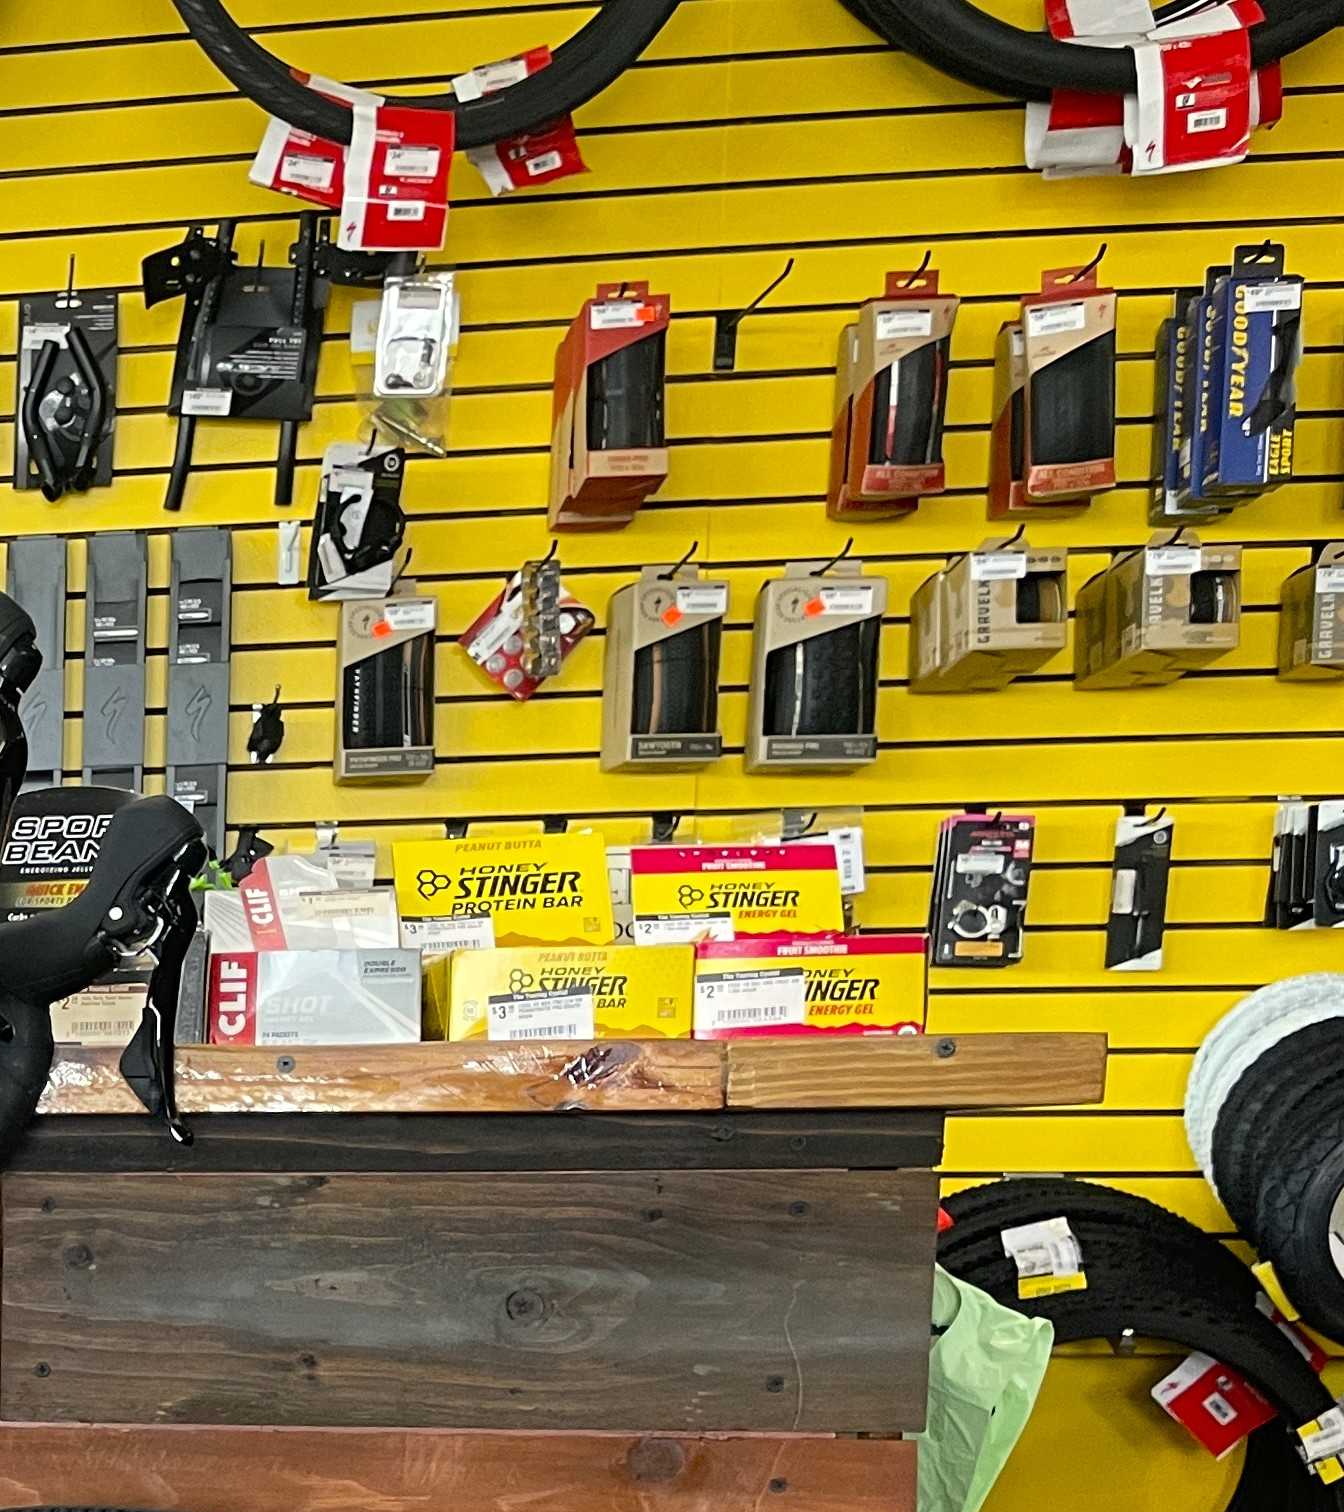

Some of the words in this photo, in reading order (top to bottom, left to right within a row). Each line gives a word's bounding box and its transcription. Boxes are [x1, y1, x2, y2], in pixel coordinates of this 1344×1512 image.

[455, 842, 503, 853] PEANUT
[504, 839, 543, 850] BUTTA
[459, 862, 549, 876] HONEY
[454, 871, 581, 900] STINGER
[710, 881, 776, 891] HONEY
[451, 897, 537, 915] PROTEIN
[542, 896, 584, 908] BAR
[706, 890, 800, 909] STINGER
[245, 888, 274, 926] CLIF
[738, 910, 777, 919] ENERGY
[779, 909, 797, 918] GEL
[540, 967, 607, 977] HONEY
[803, 968, 856, 979] ONEY
[804, 979, 881, 1002] INGER
[218, 960, 248, 1037] CLIF
[265, 994, 336, 1015] SHOT
[596, 998, 627, 1009] BAR
[809, 1003, 852, 1016] ENERGY
[854, 1003, 874, 1015] GEL
